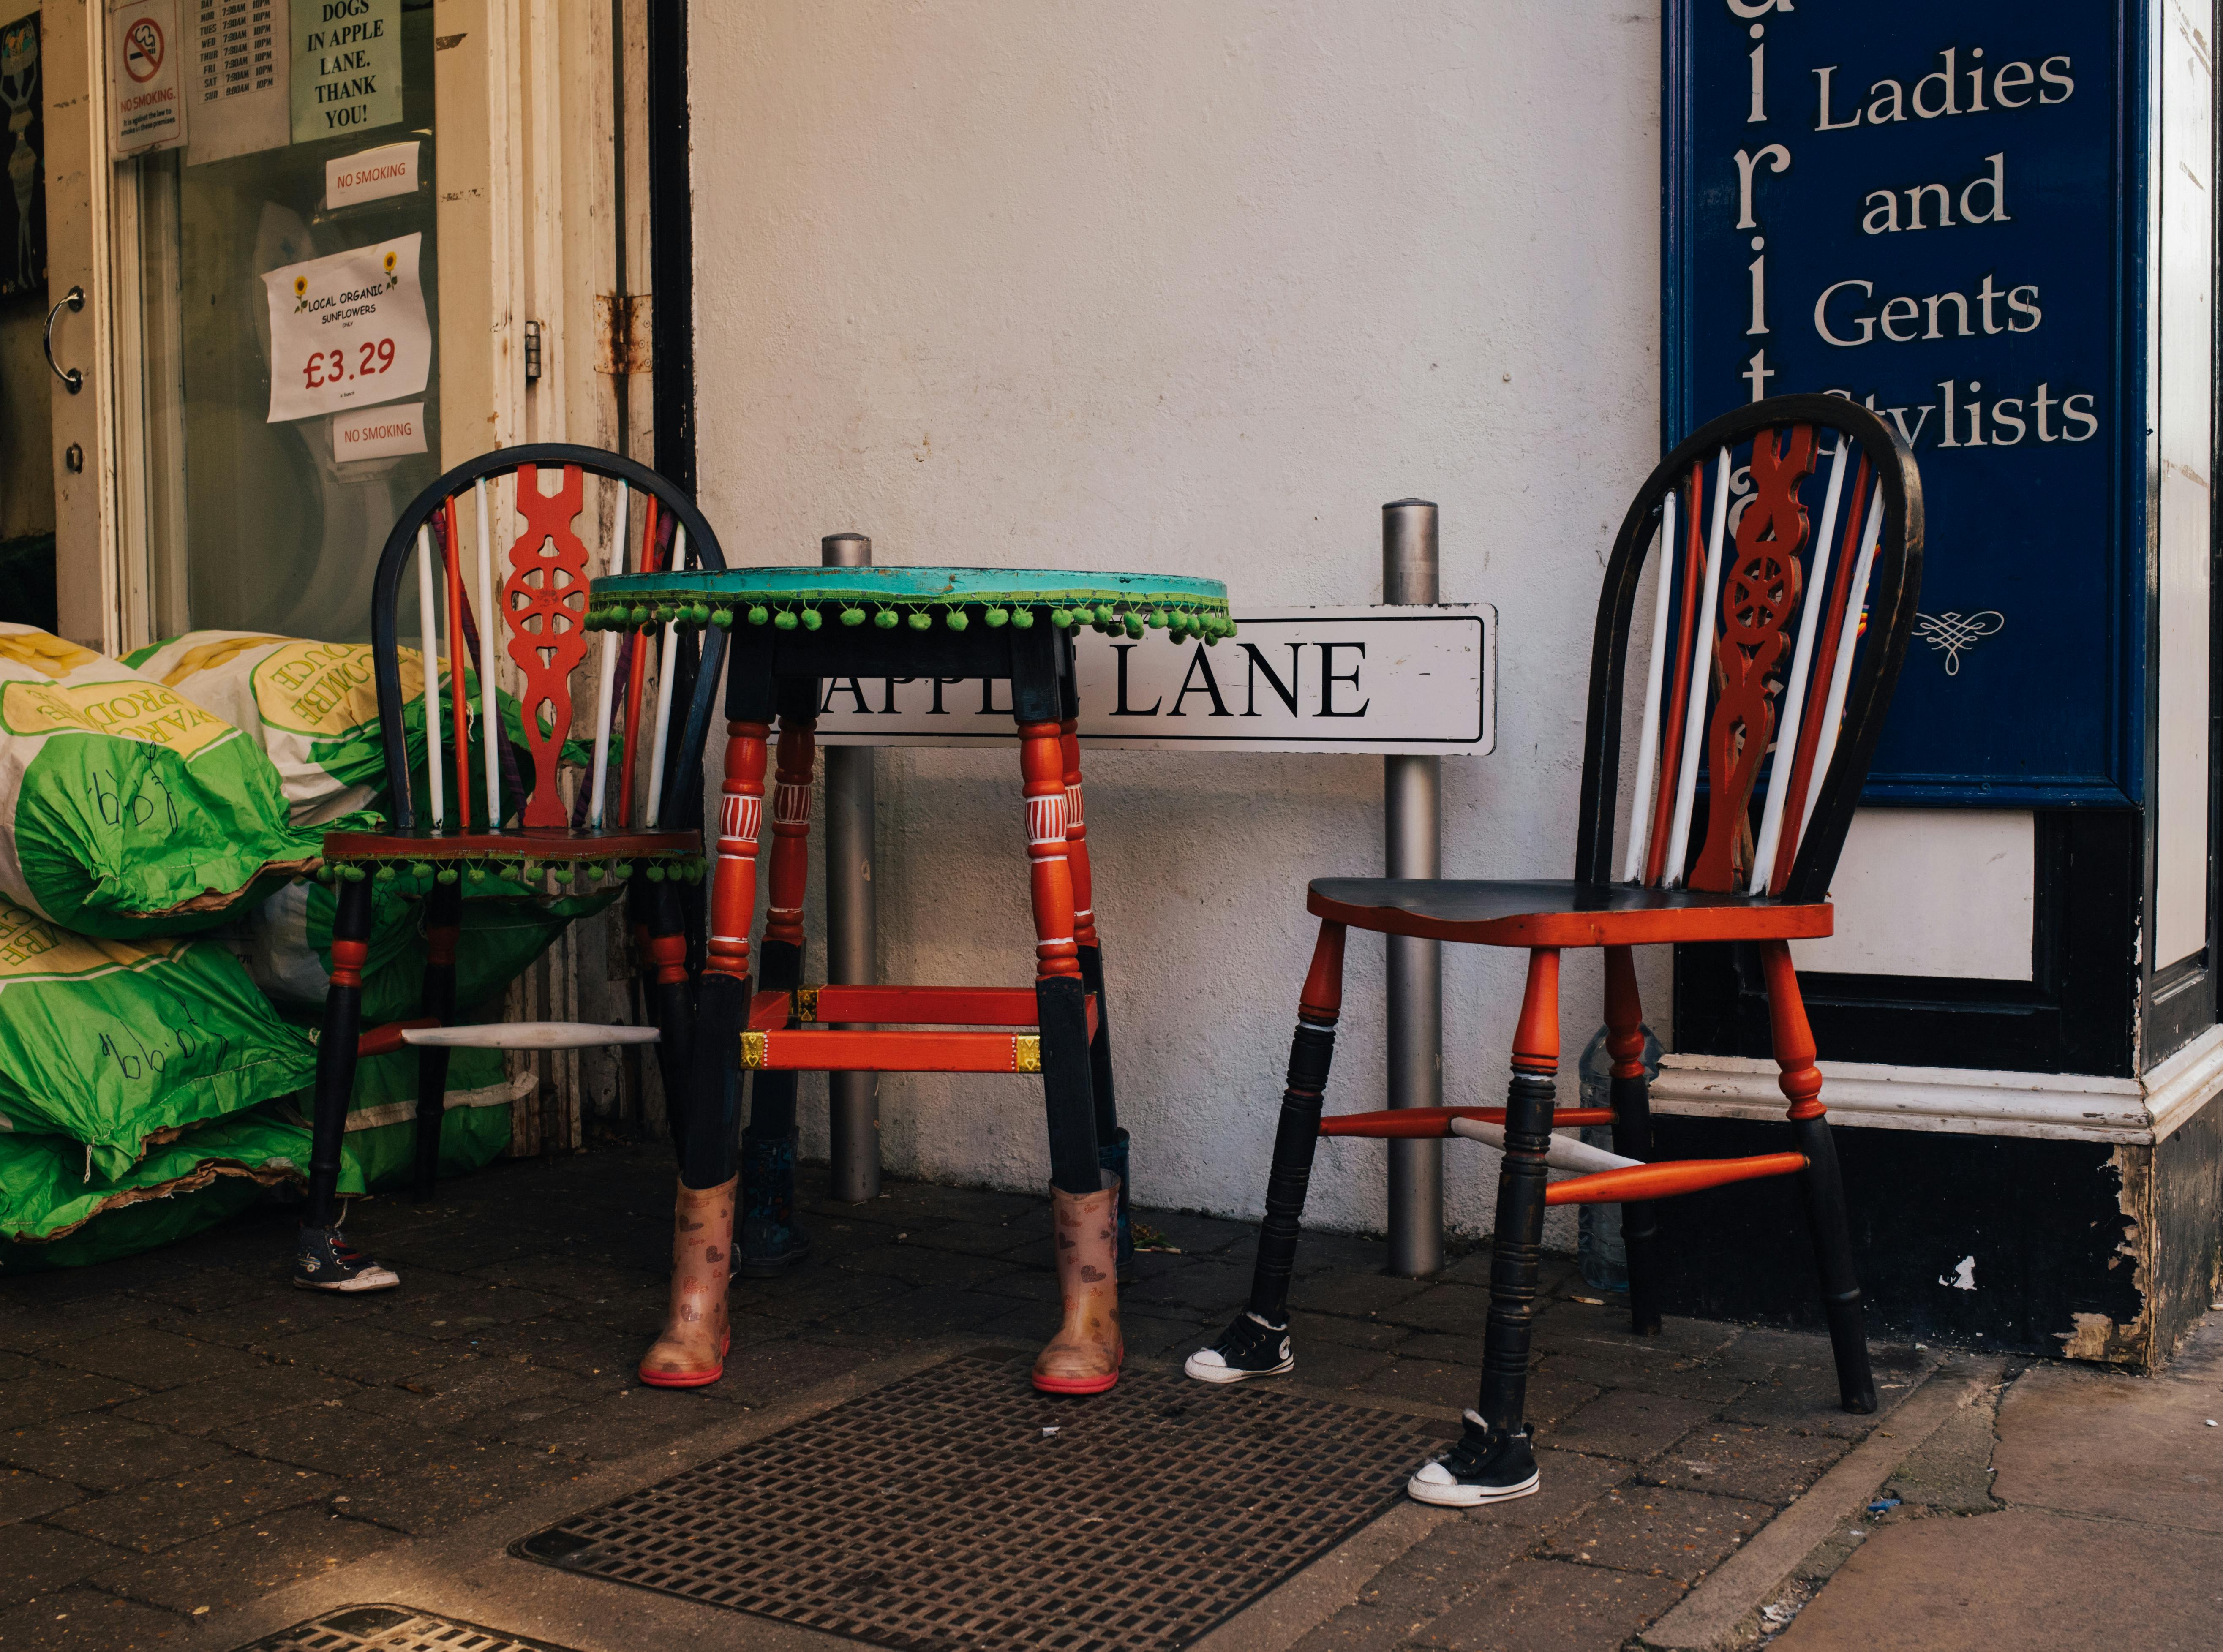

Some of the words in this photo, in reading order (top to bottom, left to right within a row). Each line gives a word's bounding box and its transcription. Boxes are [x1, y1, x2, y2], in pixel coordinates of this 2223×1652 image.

[200, 24, 216, 36] TUES
[223, 16, 246, 30] 7:30AM
[253, 11, 270, 22] 10PM
[201, 11, 214, 22] MON
[223, 3, 245, 16] 7:30AM
[253, 0, 270, 9] 10PM
[322, 0, 369, 22] DOGS
[202, 38, 216, 48] WED
[223, 30, 247, 43] 7:30AM
[254, 24, 271, 35] 10PM
[307, 32, 324, 52] IN
[329, 19, 384, 47] APPLE
[200, 50, 218, 62] THUR
[224, 44, 247, 56] 7:30AM
[254, 37, 271, 49] 10PM
[204, 64, 215, 74] FRI
[225, 57, 248, 69] 7:30AM
[255, 51, 272, 62] 10PM
[320, 50, 370, 76] LANE.
[204, 77, 217, 88] SAT
[226, 70, 249, 82] 7:30AM
[256, 64, 272, 76] 10PM
[1812, 46, 2074, 131] Ladies
[121, 99, 132, 113] NO
[133, 87, 176, 110] SMOKING.
[205, 90, 218, 101] SUN
[226, 83, 249, 96] 9:00AM
[256, 78, 273, 89] 10PM
[315, 75, 376, 103] THANK
[121, 127, 136, 136] smoke
[153, 117, 175, 129] premises
[133, 114, 148, 125] against
[148, 112, 156, 120] the
[325, 104, 367, 128] YOU!
[338, 174, 353, 189] NO
[356, 163, 406, 185] SMOKING
[1862, 152, 2011, 235] and
[308, 296, 337, 313] LOCAL
[340, 283, 383, 304] ORGANIC
[1814, 273, 2042, 346] Gents
[322, 304, 376, 324] SUNFLOWERS
[303, 338, 395, 389] £3.29
[1817, 379, 2098, 455] ylists
[345, 429, 360, 443] NO
[362, 422, 412, 441] SMOKING
[1109, 642, 1370, 718] LANE
